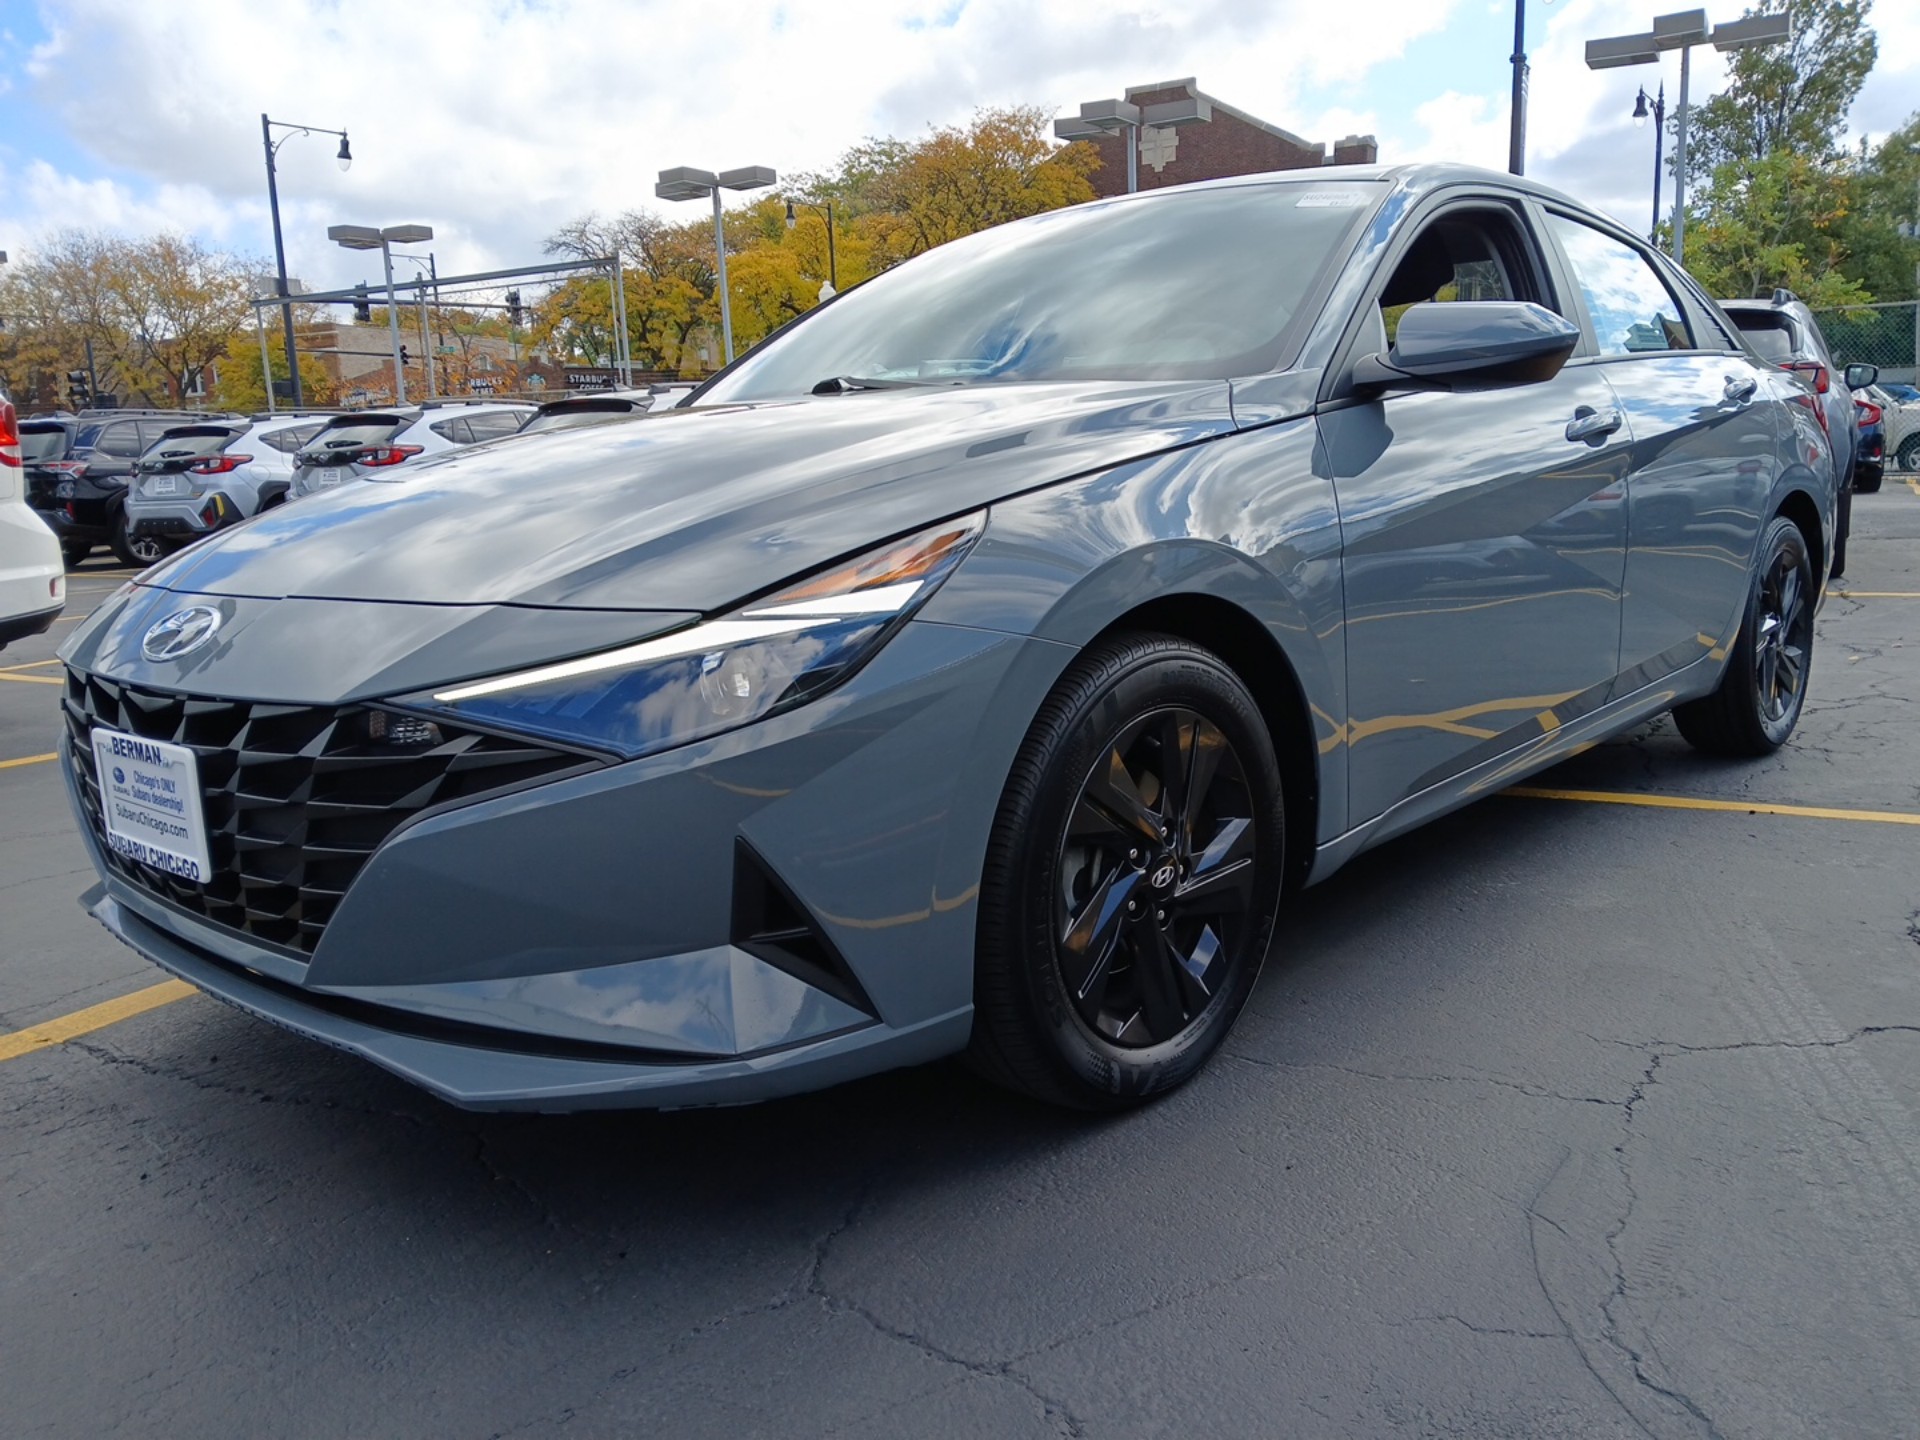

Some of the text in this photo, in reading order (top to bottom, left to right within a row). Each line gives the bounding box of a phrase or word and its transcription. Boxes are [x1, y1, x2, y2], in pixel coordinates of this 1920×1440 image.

[111, 736, 162, 766] BERMAN
[131, 784, 152, 803] Subaru
[133, 770, 176, 794] Chicago's ONLY
[115, 803, 189, 839] SubaruChicago.com
[108, 831, 199, 881] SUBARU CHICAGO
